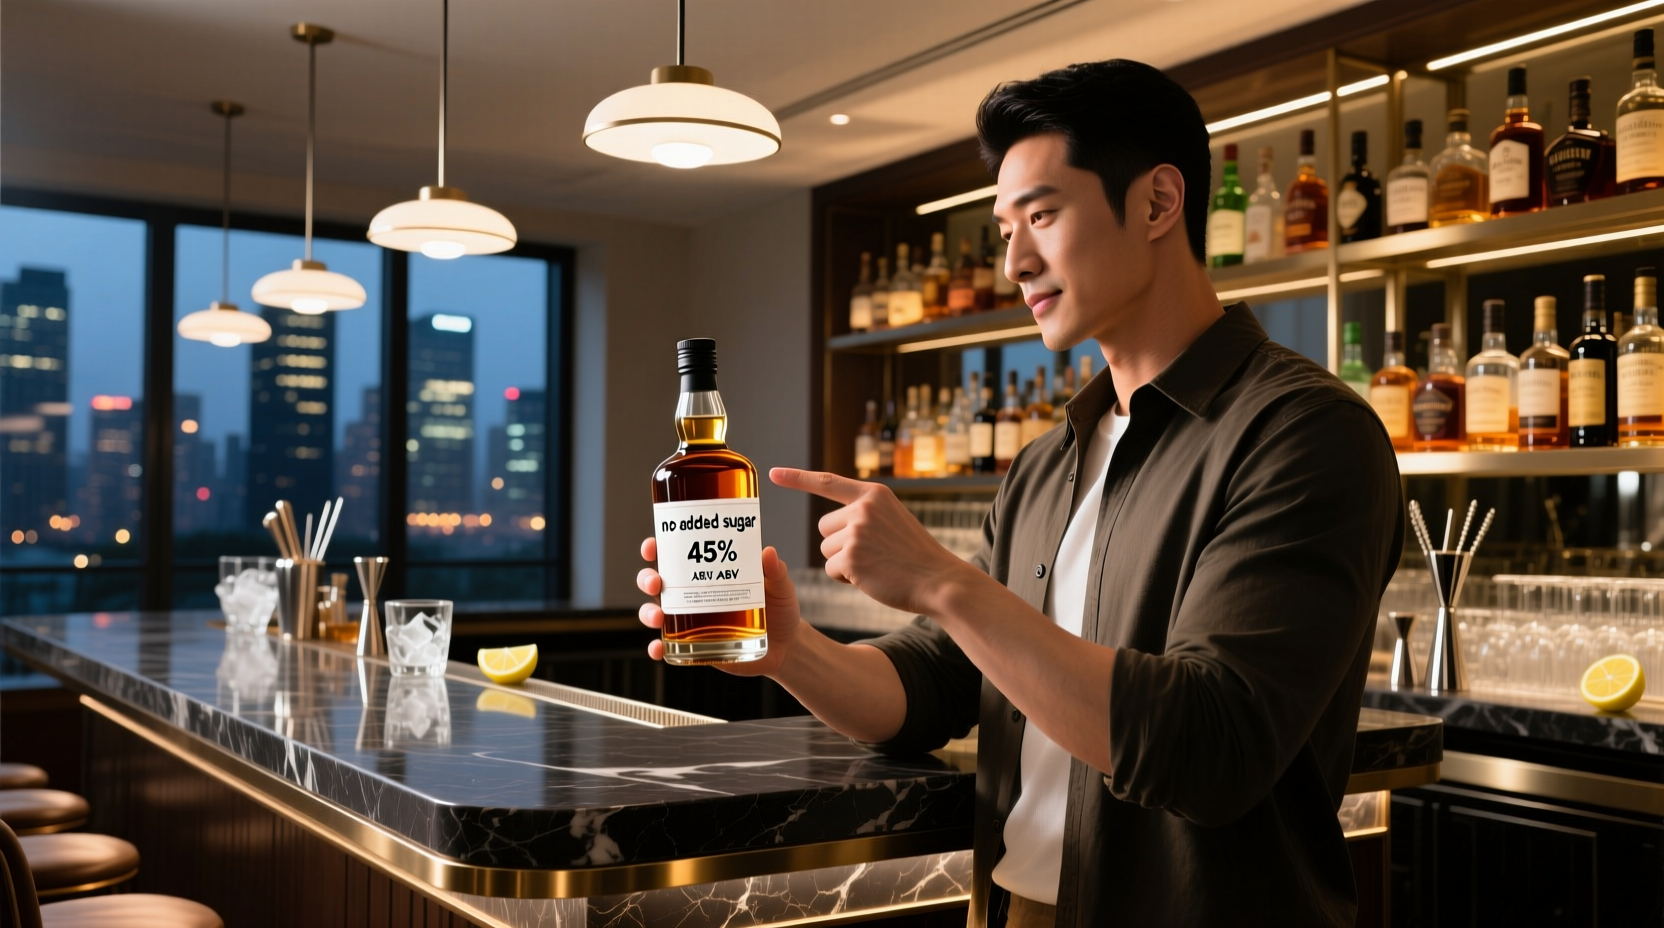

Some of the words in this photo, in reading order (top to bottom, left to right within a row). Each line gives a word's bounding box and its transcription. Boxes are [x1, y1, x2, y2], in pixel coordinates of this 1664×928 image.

[662, 520, 677, 532] no
[680, 513, 719, 531] added
[723, 516, 756, 532] sugar
[687, 539, 738, 563] 45%
[716, 569, 739, 580] ABV
